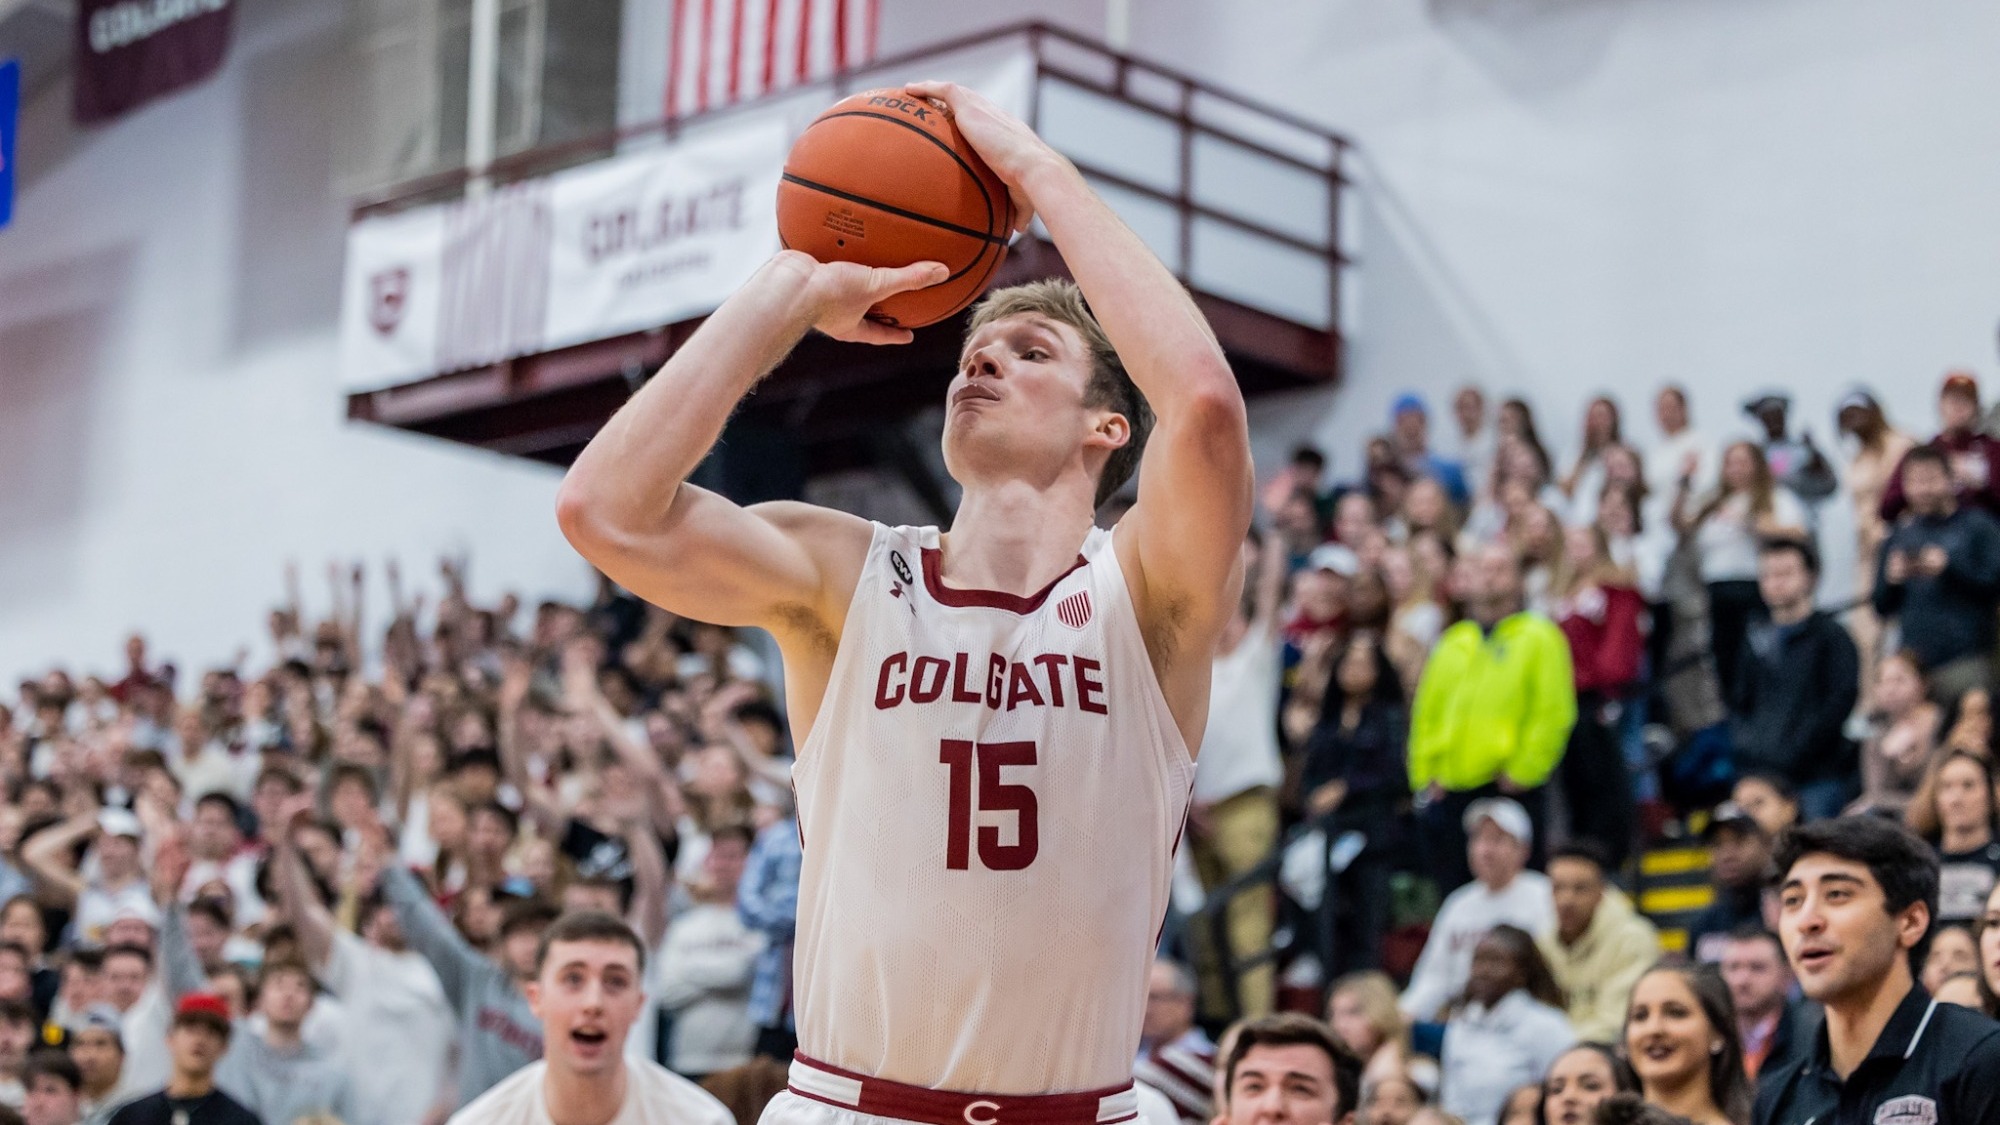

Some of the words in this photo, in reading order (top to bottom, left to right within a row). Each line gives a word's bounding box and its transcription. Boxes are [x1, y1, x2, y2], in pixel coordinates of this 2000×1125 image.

[868, 96, 932, 121] ROCK
[875, 651, 1108, 715] COLGATE
[939, 738, 1038, 871] 15
[964, 1100, 1000, 1125] C
